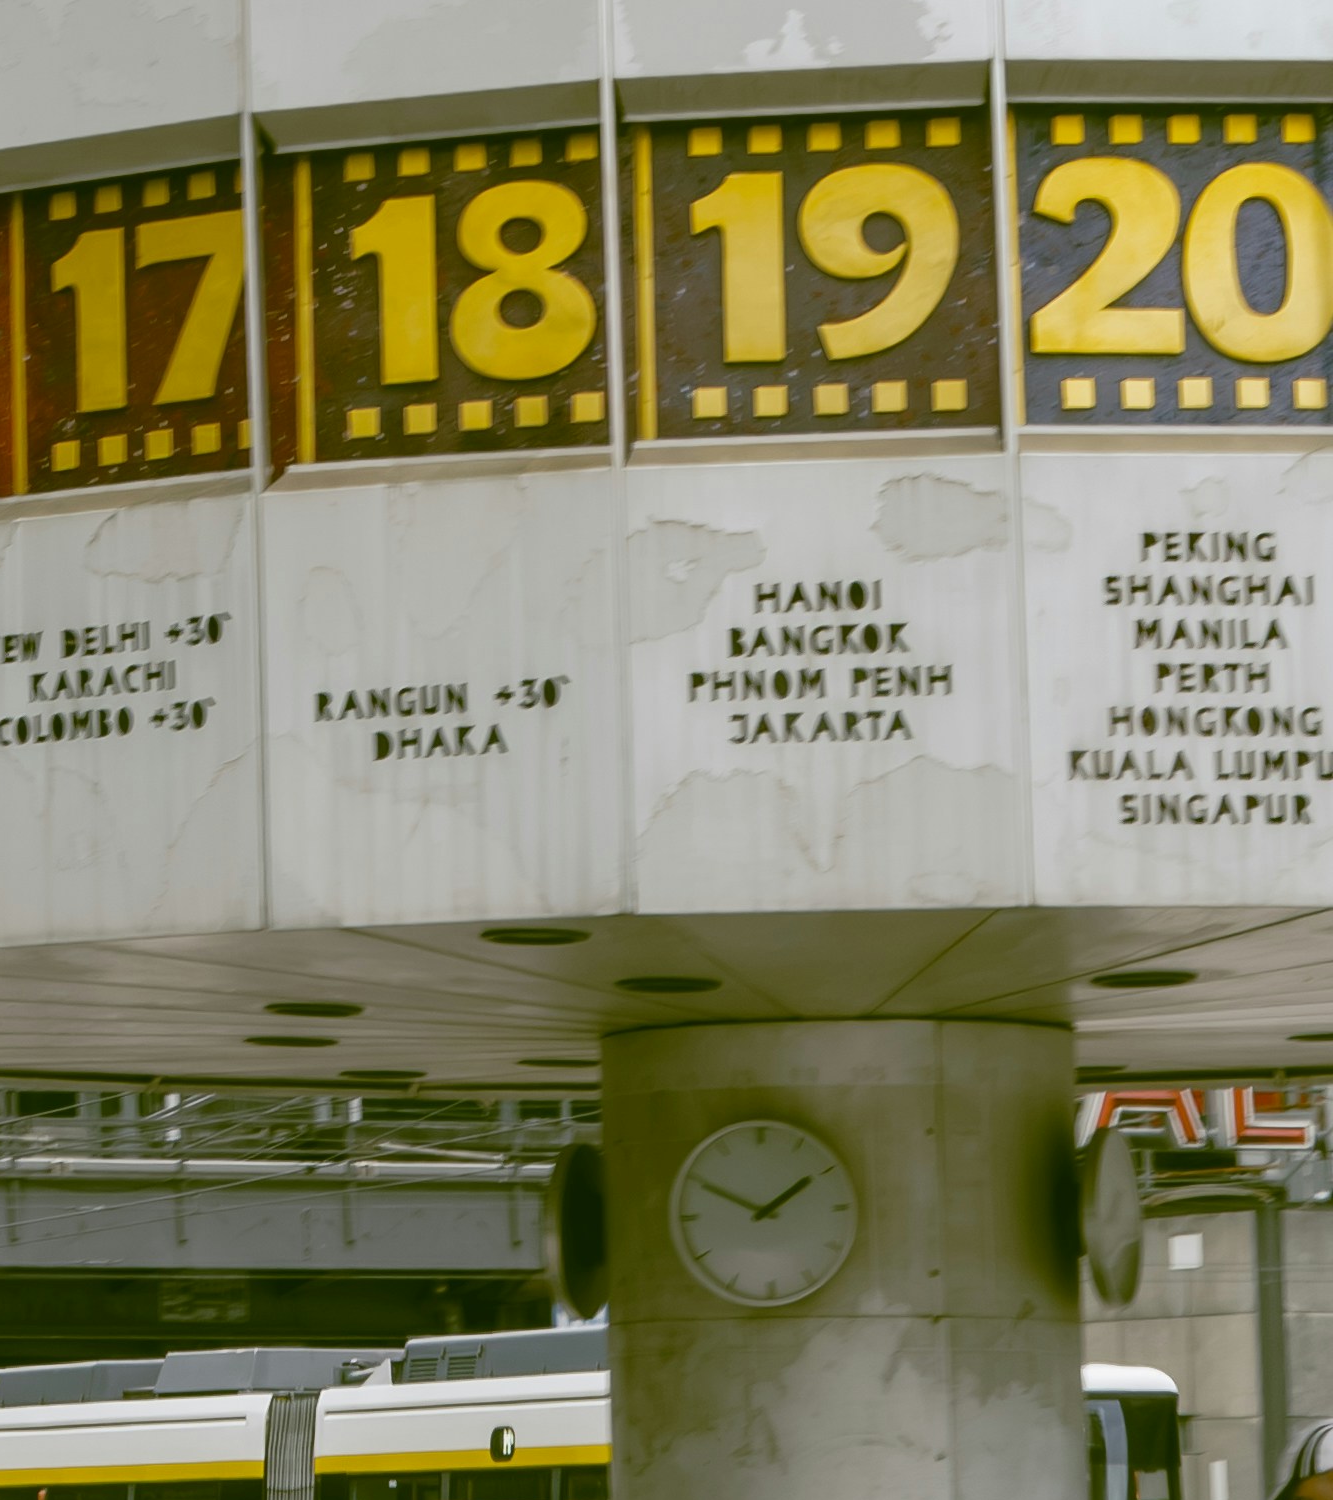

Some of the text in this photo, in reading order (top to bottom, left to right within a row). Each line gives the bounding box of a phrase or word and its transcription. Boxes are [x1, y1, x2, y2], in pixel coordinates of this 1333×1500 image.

[689, 160, 960, 364] 19
[1031, 156, 1333, 363] 20
[348, 178, 598, 386] 18
[50, 207, 263, 413] 17
[1139, 532, 1276, 562] PEKING
[754, 580, 883, 615] HANOI
[1103, 574, 1315, 606] SHANGHAI
[60, 620, 151, 658] DELHI
[727, 622, 911, 660] BANGKOK
[1133, 618, 1288, 650] MANILA
[28, 660, 176, 703] KARACHI
[686, 664, 953, 703] PHNOM PENH
[1154, 662, 1271, 693] PERTH
[314, 682, 469, 723] RANGUN
[1107, 706, 1323, 736] HONGKONG
[373, 723, 509, 762] DHAKA
[728, 709, 914, 745] JAKARTA
[1067, 750, 1333, 781] KUALA LUMPU
[1119, 794, 1311, 824] SINGAPUR
